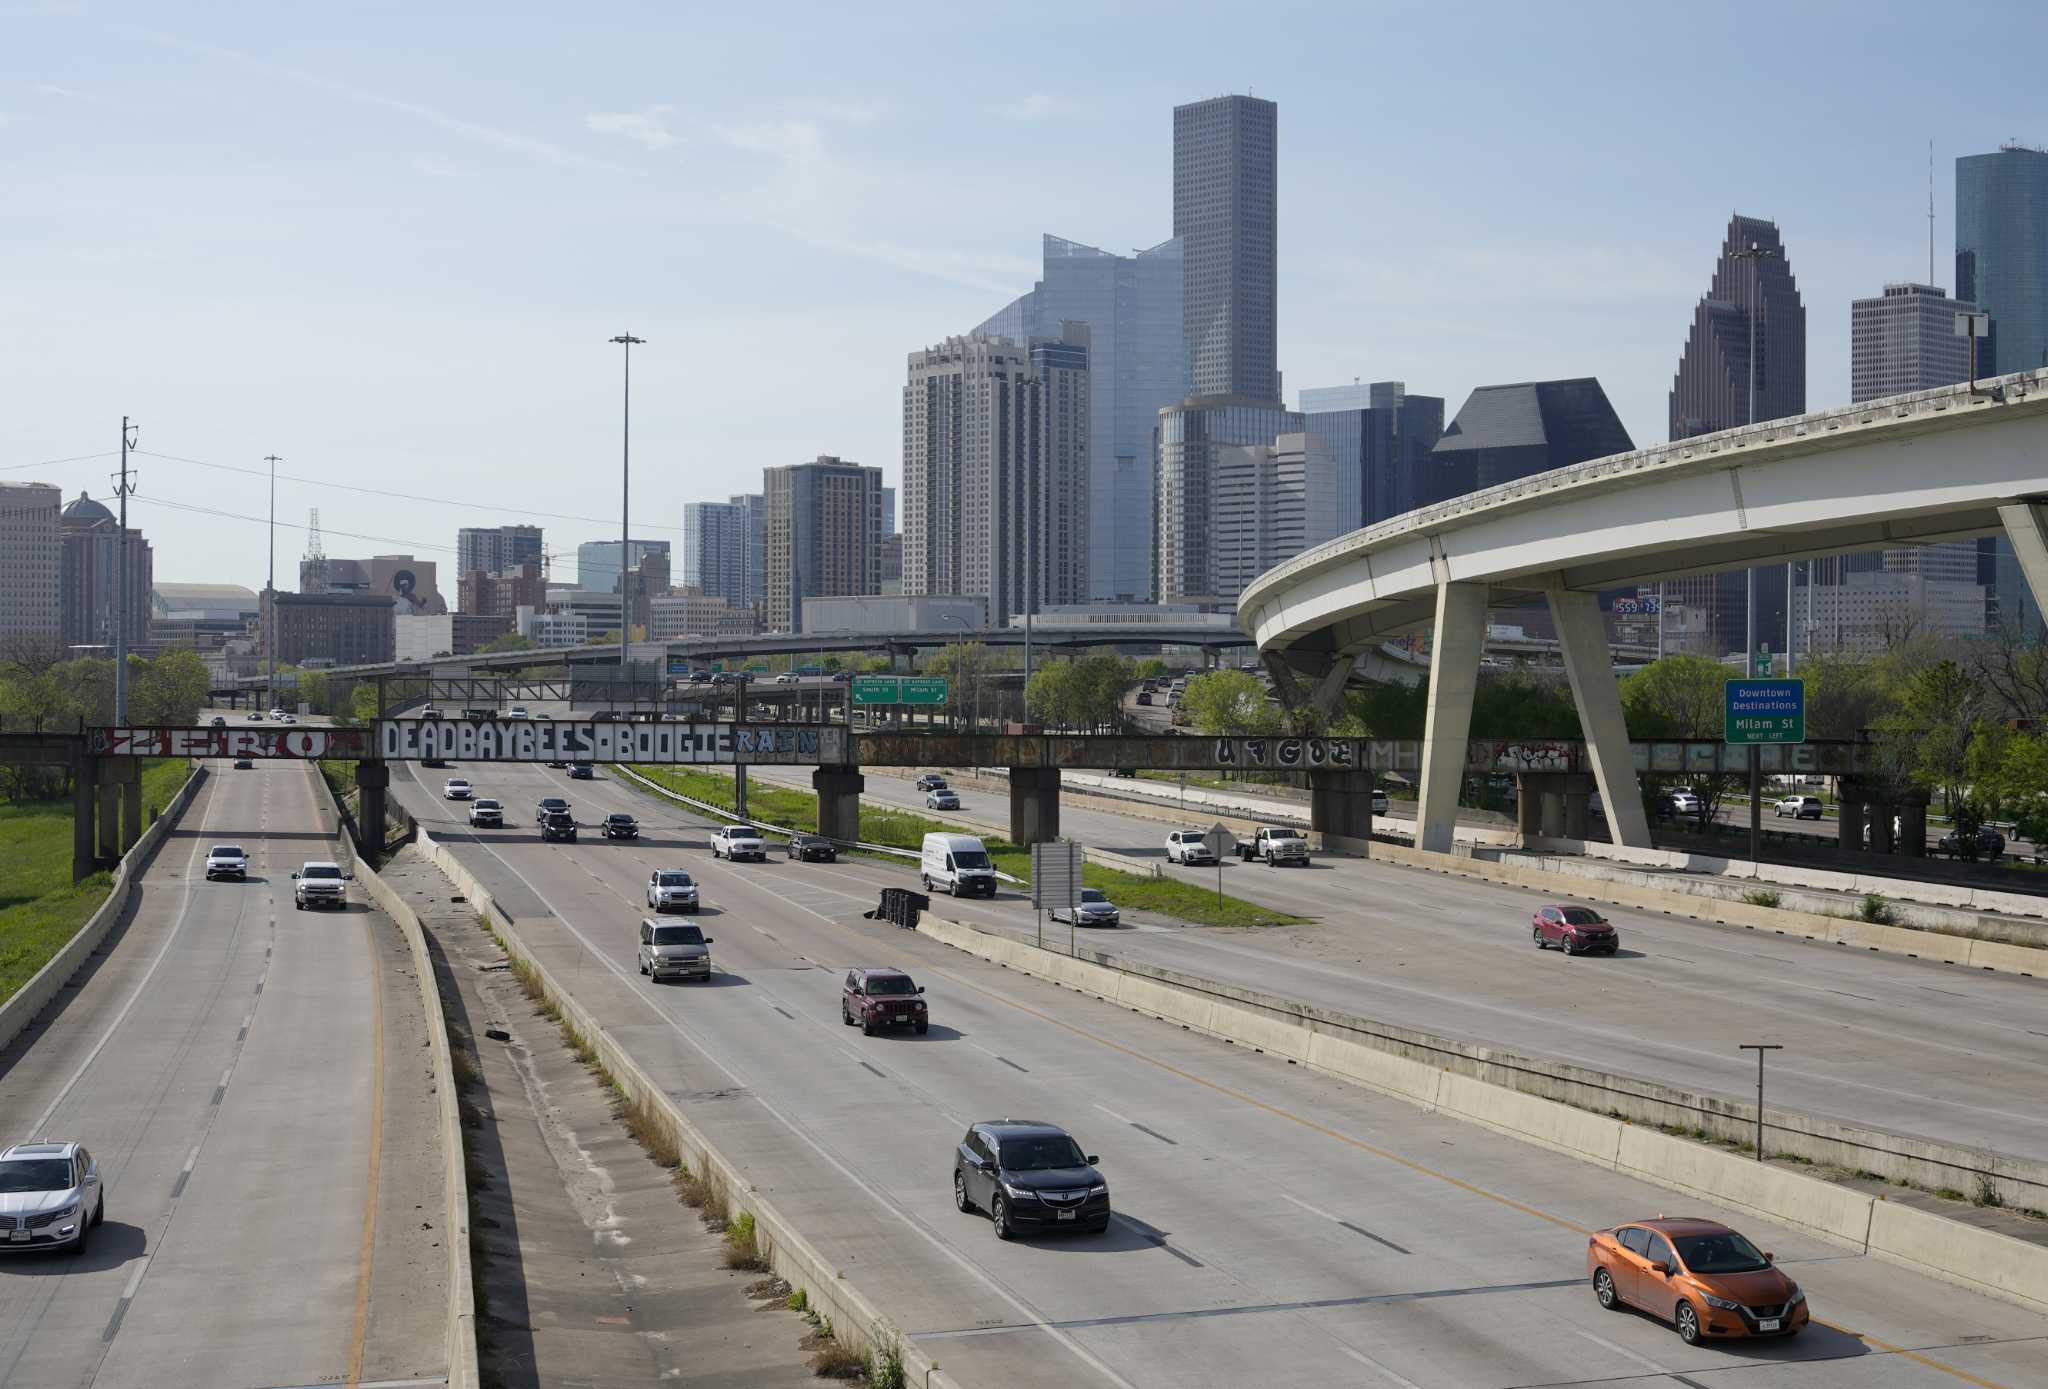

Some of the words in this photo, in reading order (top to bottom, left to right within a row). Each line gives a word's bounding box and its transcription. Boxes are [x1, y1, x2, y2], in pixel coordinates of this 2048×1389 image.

[1739, 688, 1791, 698] Downtown
[1733, 701, 1797, 710] Destinations
[1736, 718, 1773, 729] Milam
[1782, 718, 1794, 729] St
